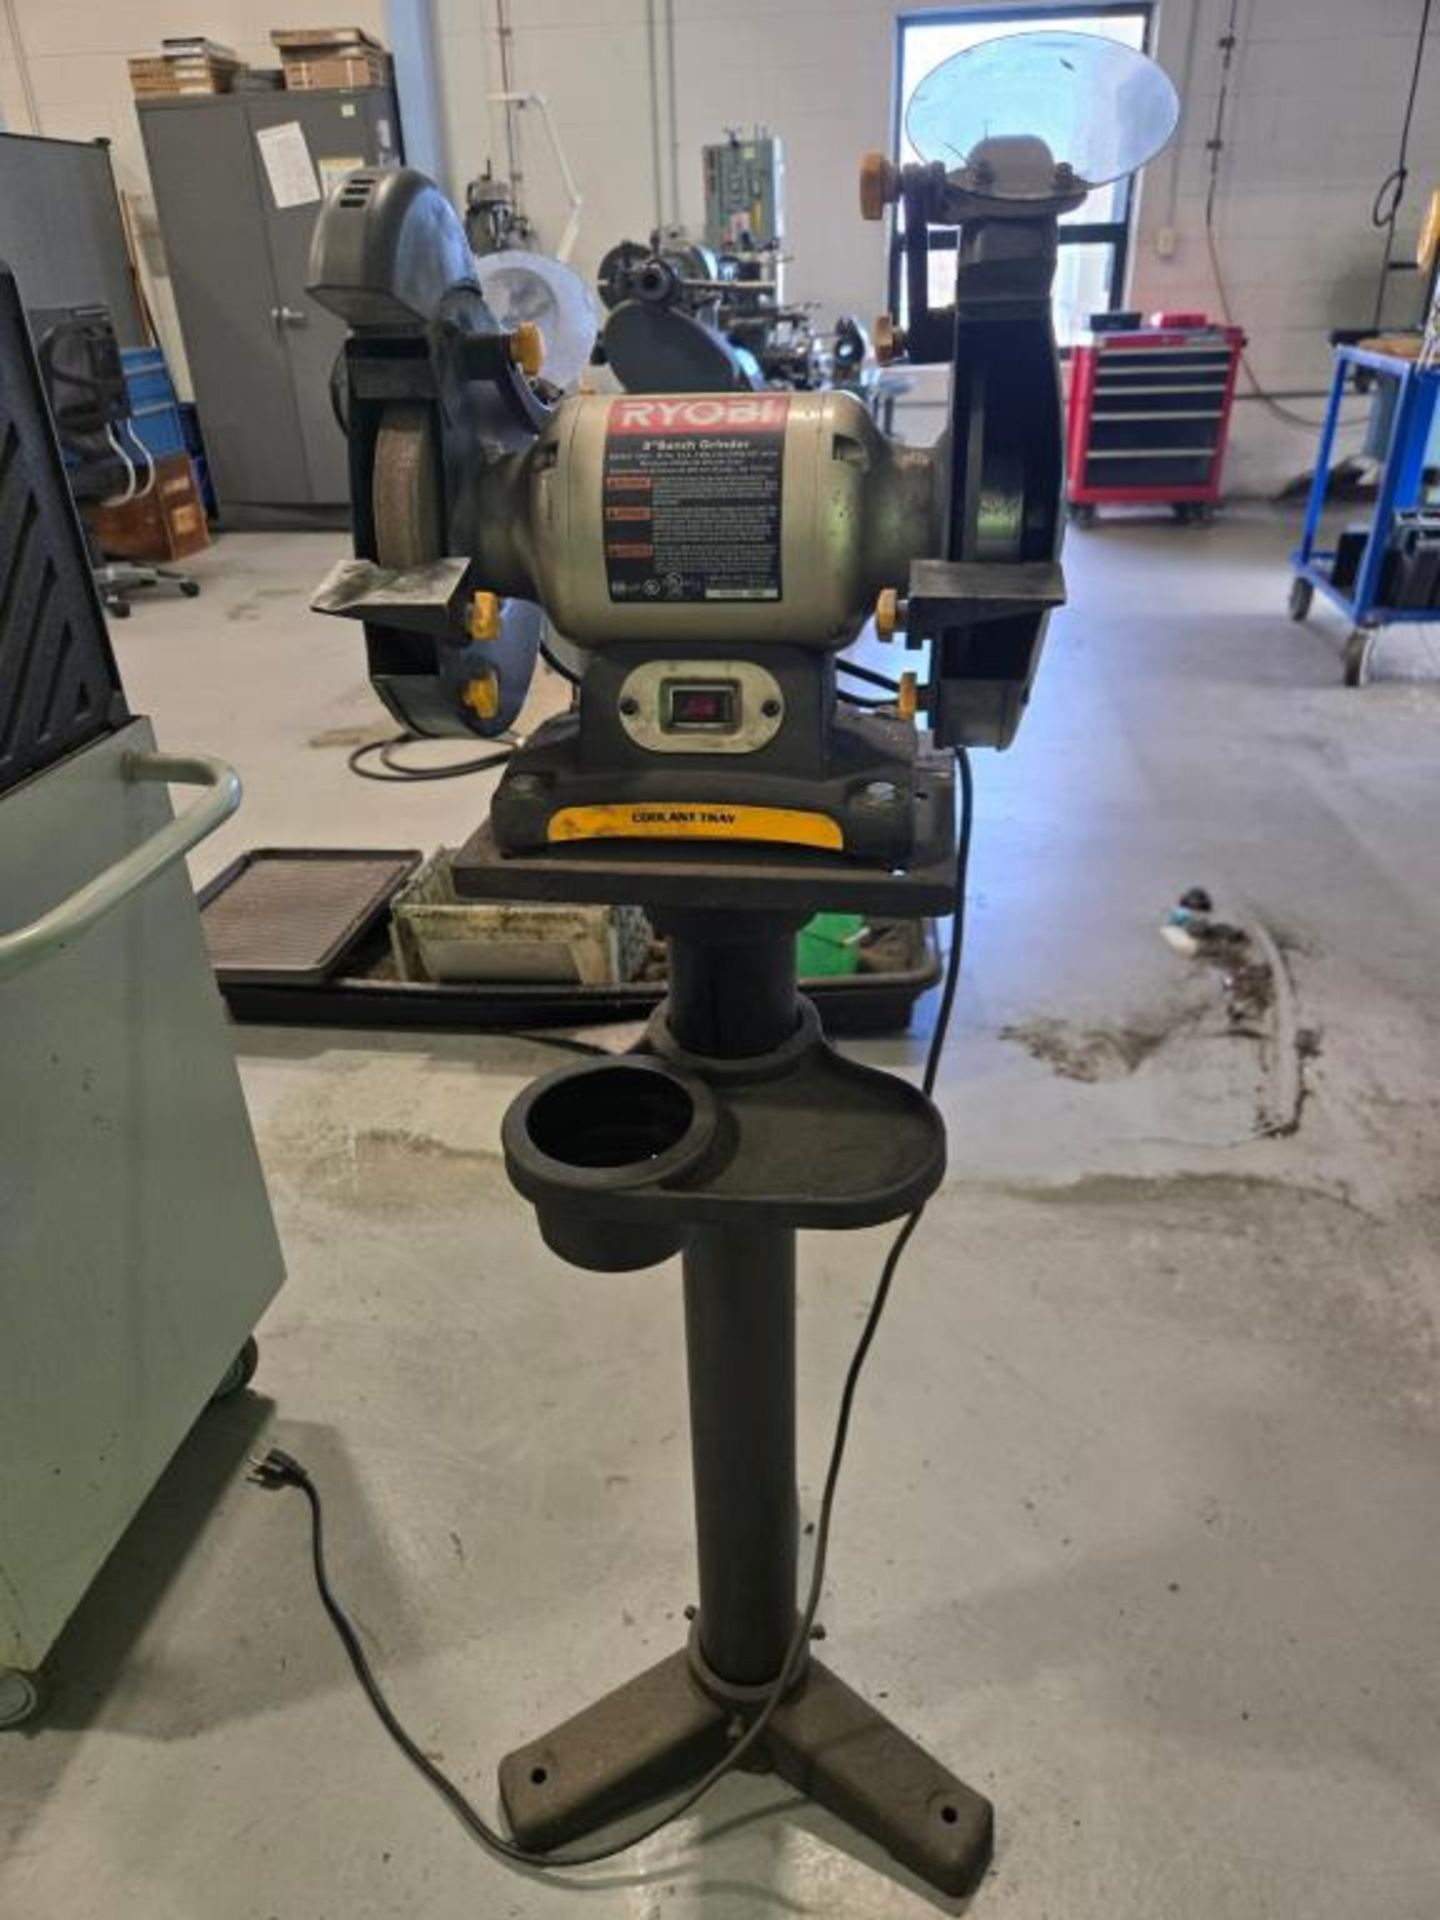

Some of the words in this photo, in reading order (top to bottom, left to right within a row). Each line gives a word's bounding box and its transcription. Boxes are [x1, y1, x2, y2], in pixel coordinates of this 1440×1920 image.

[622, 400, 783, 427] RYOBI
[632, 810, 695, 823] COOLANT
[700, 811, 736, 824] TRAY
